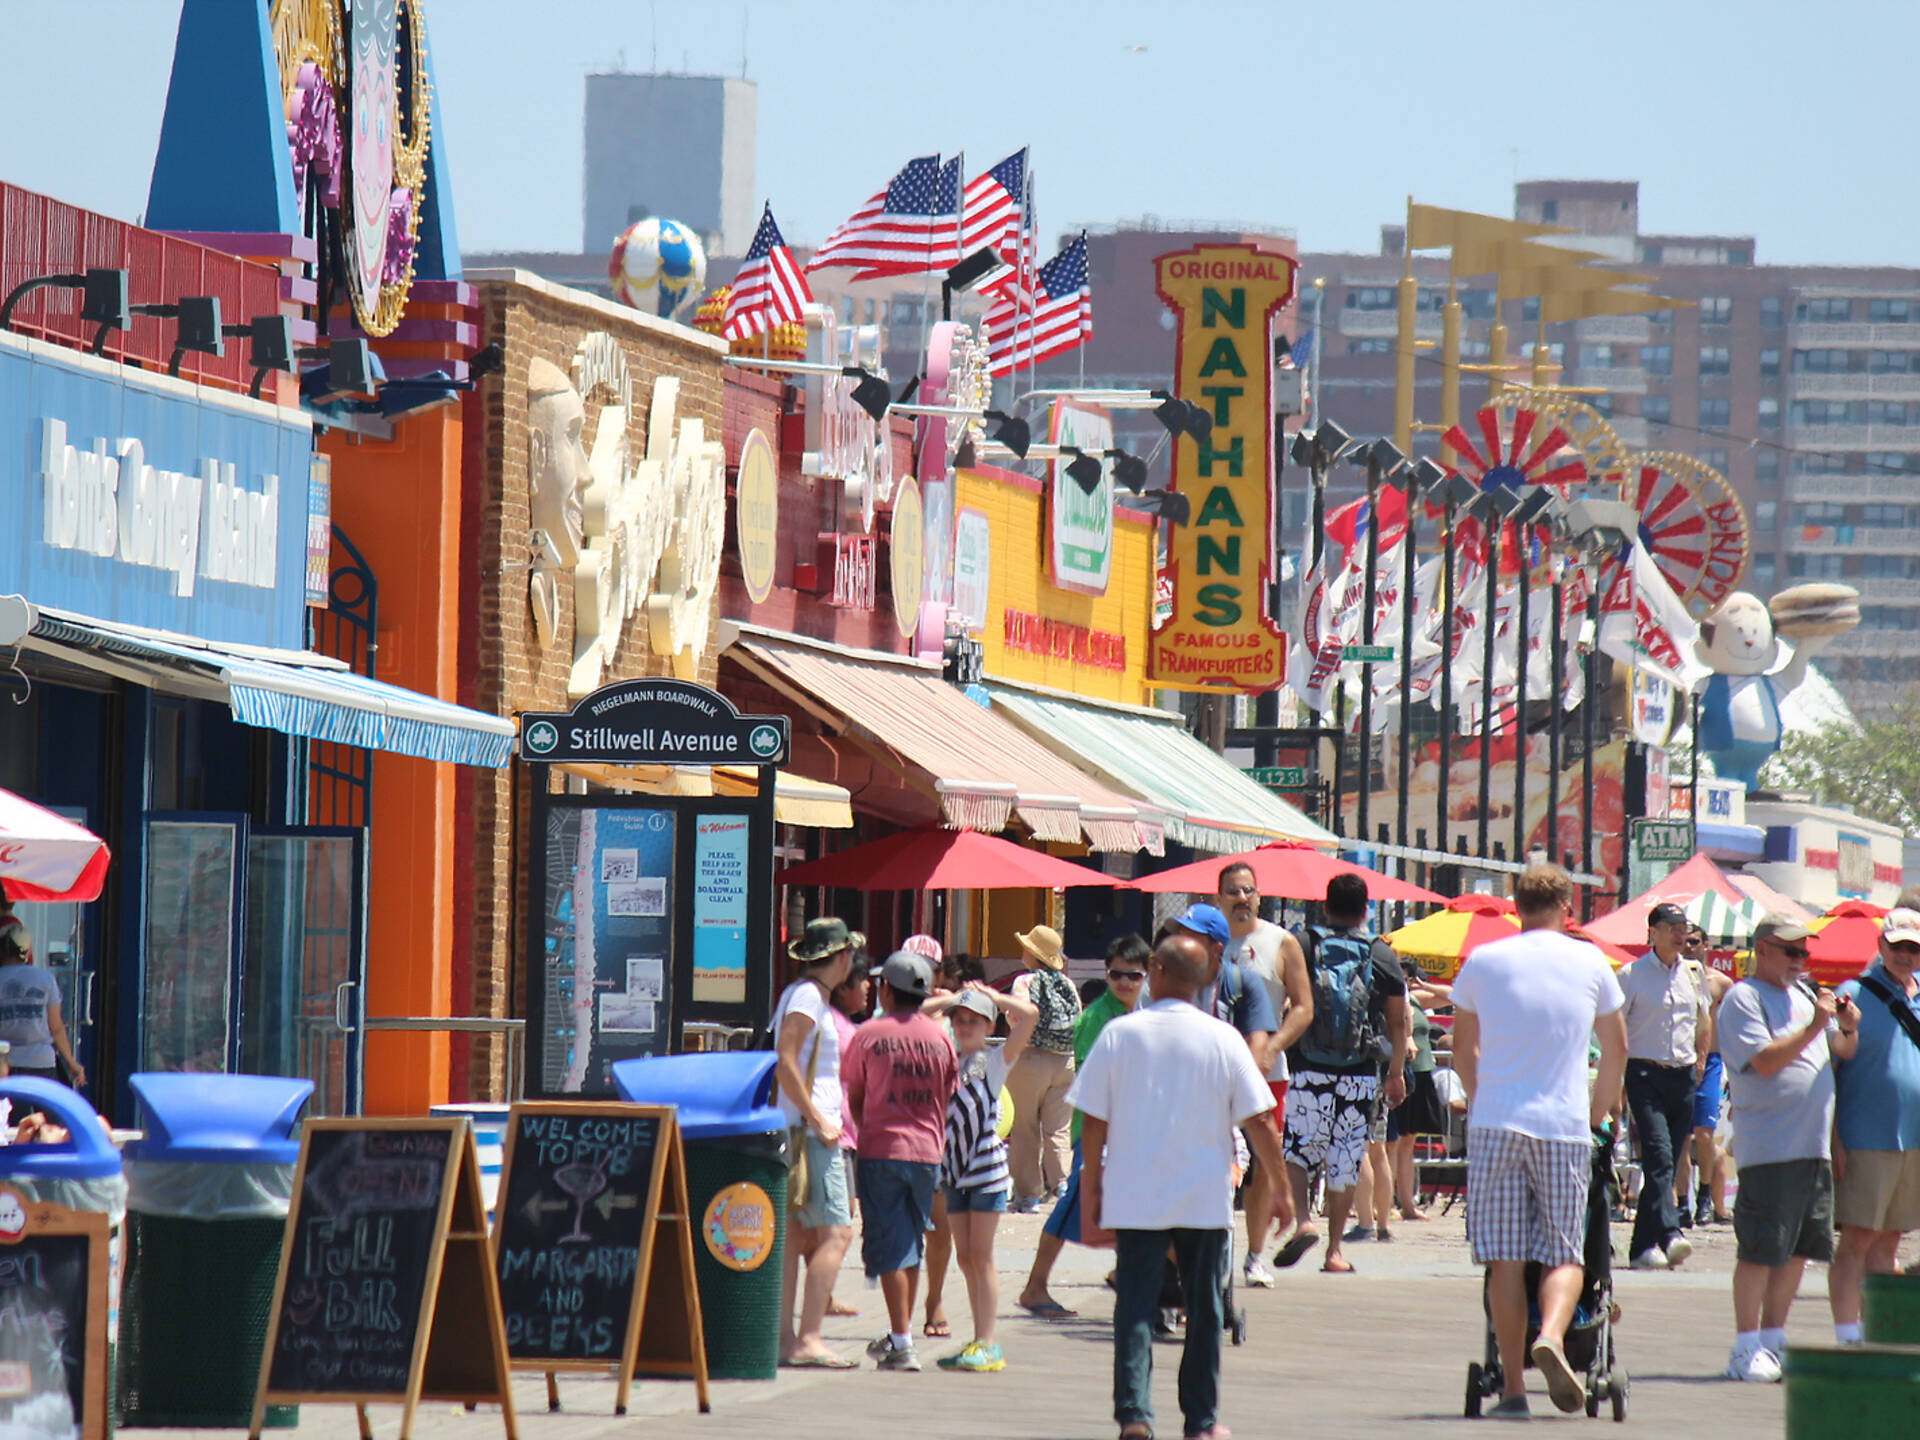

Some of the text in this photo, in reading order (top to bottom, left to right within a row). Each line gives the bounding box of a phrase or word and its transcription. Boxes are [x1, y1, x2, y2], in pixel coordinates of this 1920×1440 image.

[1169, 261, 1280, 281] ORIGINAL
[42, 417, 118, 557] Tom's
[117, 437, 203, 597] Coney
[200, 458, 279, 588] Island
[1173, 632, 1261, 649] FAMOUS
[1159, 646, 1274, 675] FRANKFURTERS
[591, 690, 719, 718] RIEGELMANN BOARDWALK
[570, 727, 738, 752] Stillwell Avenue
[1267, 770, 1285, 785] 12
[1640, 826, 1689, 847] ATM
[707, 851, 736, 859] PLEASE
[722, 860, 742, 868] KEEP
[717, 869, 742, 877] BEACH
[697, 886, 744, 894] BOARDWALK
[709, 895, 734, 903] CLEAN
[522, 1117, 652, 1146] WELCOME
[536, 1142, 568, 1166] TO
[304, 1214, 397, 1277] FULL
[325, 1278, 402, 1333] BAR
[538, 1286, 585, 1313] AND
